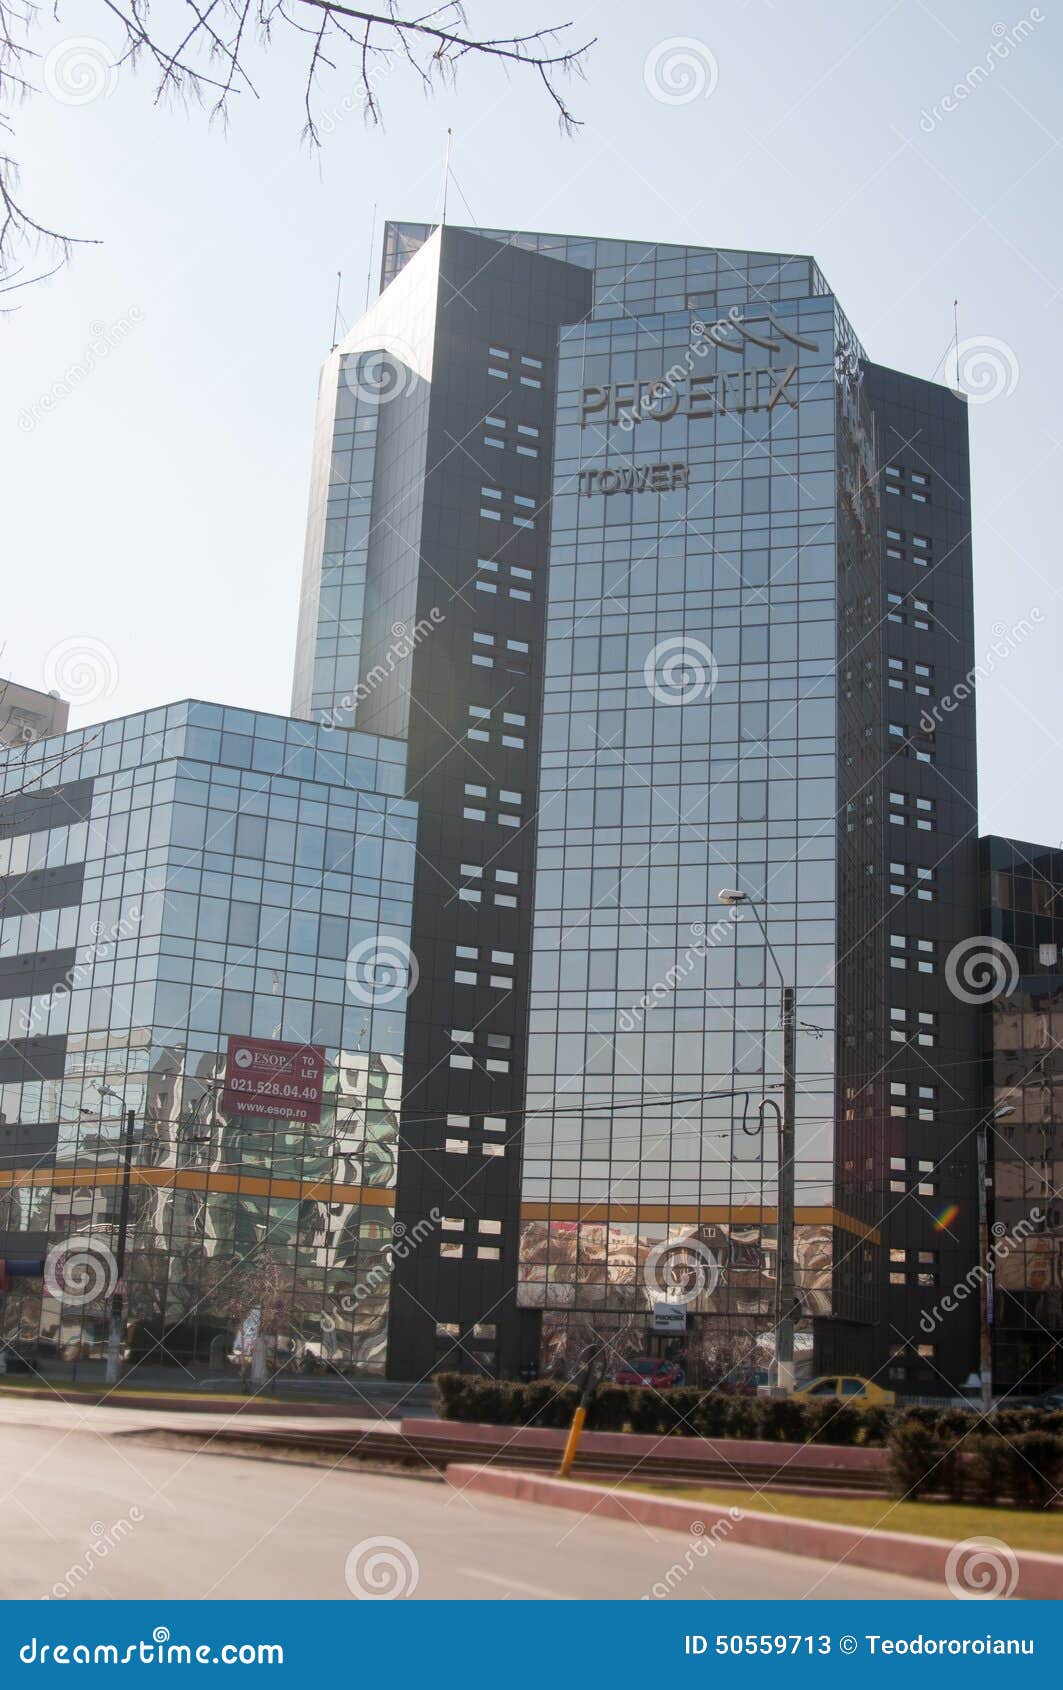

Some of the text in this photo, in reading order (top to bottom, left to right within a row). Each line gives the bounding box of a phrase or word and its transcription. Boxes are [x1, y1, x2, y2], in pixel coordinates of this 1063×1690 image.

[579, 363, 798, 429] PHOENIX
[578, 463, 690, 498] TOWER
[302, 1056, 314, 1066] TO
[301, 1069, 318, 1079] LET
[231, 1078, 317, 1100] 021.528.04.40
[237, 1102, 307, 1118] www.esop.ro
